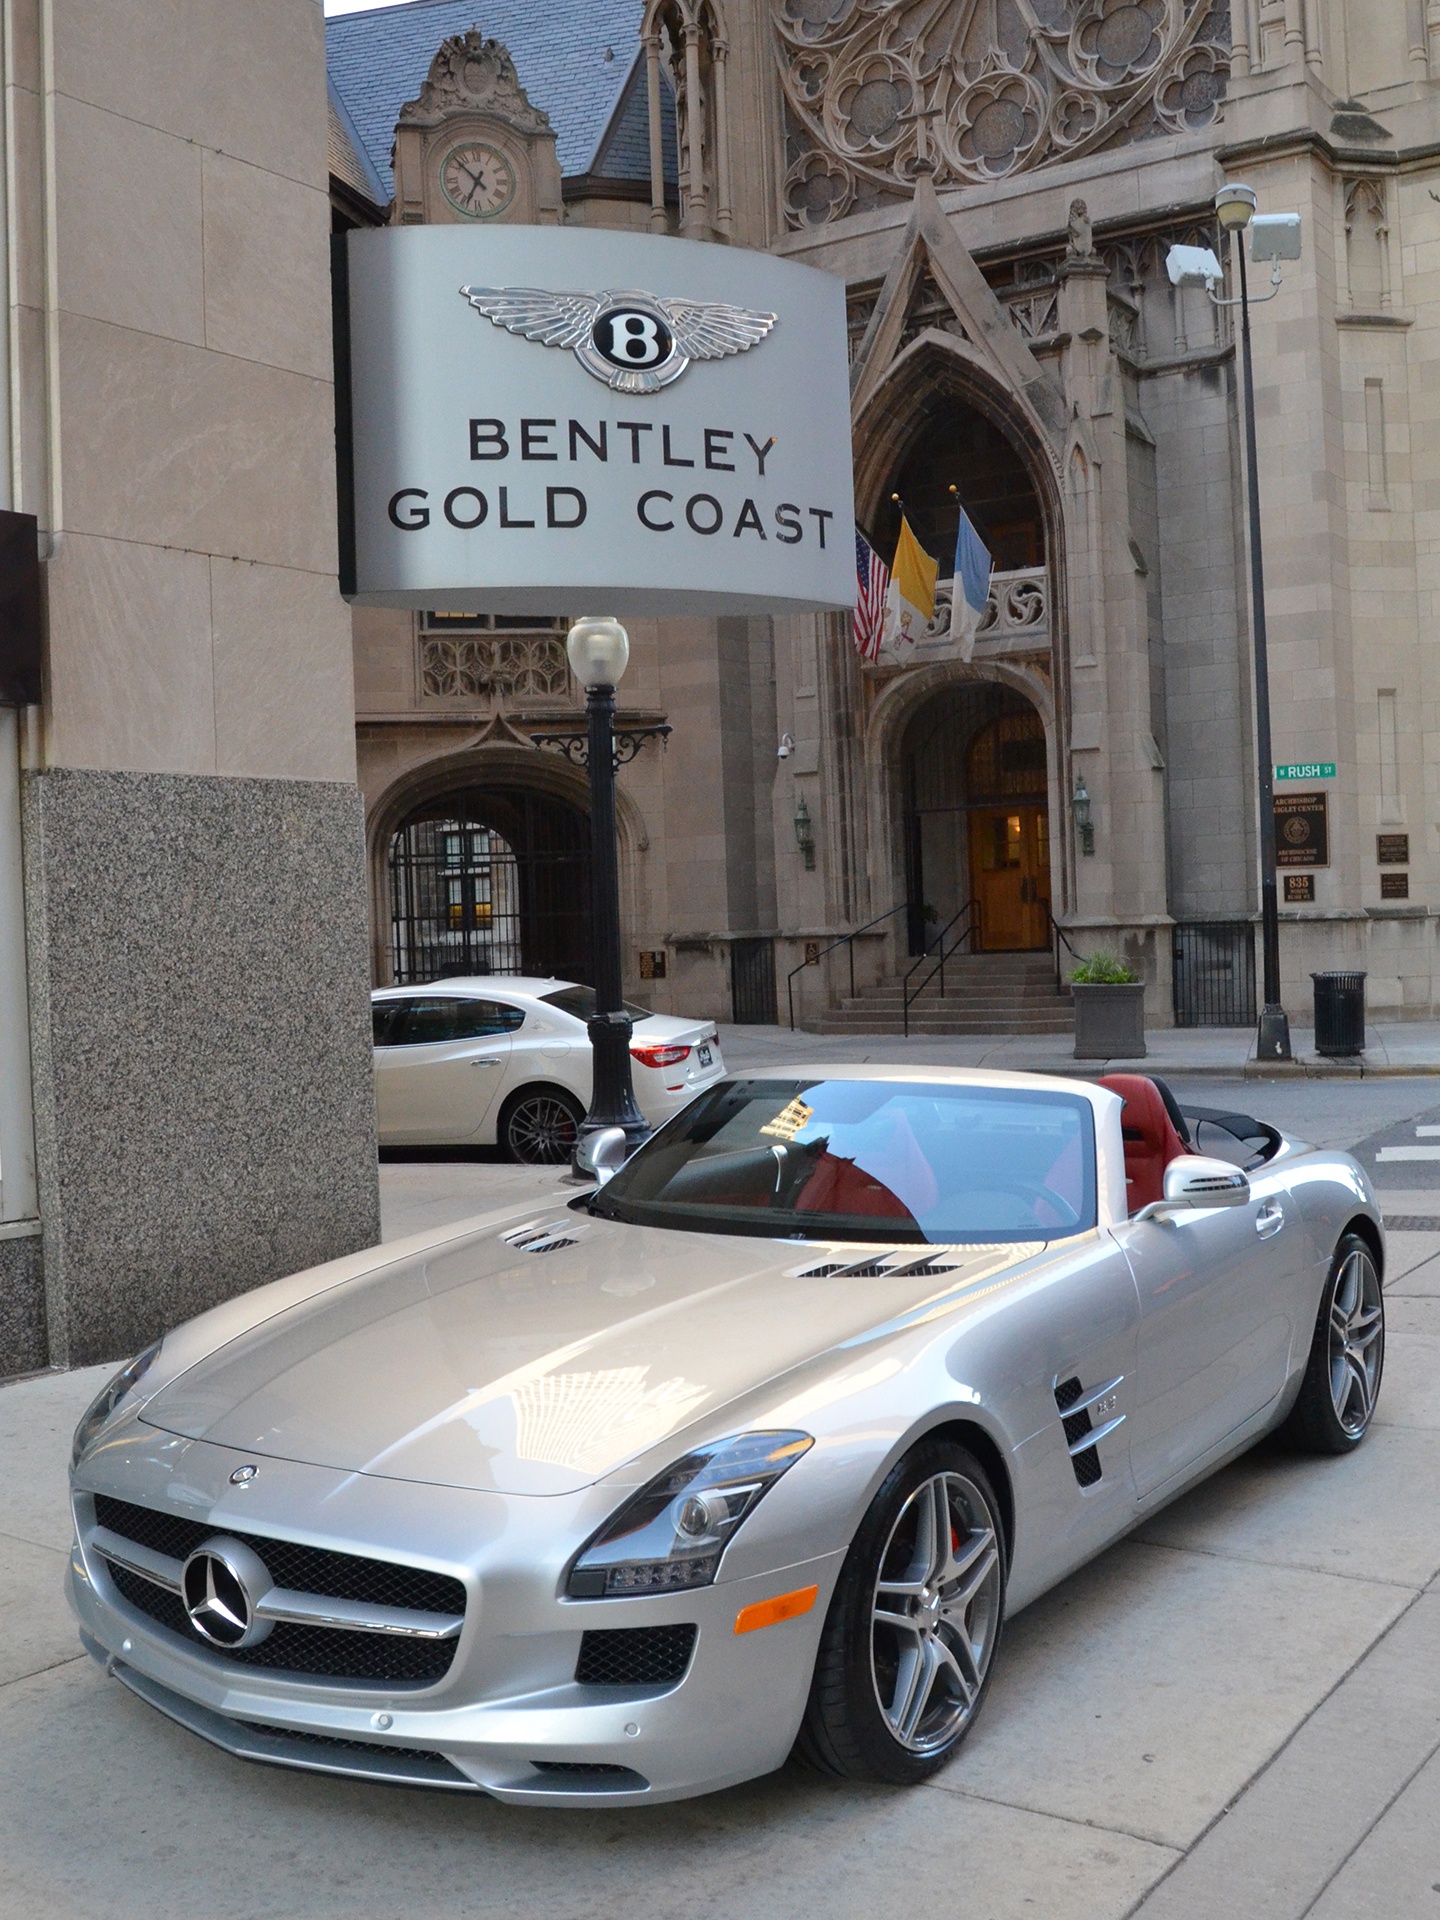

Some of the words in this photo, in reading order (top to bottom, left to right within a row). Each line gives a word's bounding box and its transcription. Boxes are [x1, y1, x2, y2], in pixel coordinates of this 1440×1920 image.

[608, 313, 659, 364] B
[469, 418, 778, 476] BENTLEY
[388, 486, 587, 531] GOLD
[637, 490, 834, 549] COAST
[1279, 768, 1285, 776] N
[1288, 765, 1320, 778] RUSH
[1324, 766, 1332, 774] ST
[1275, 797, 1317, 805] ARCHBISHOP
[1273, 805, 1296, 813] UIGLEY
[1297, 804, 1324, 812] CENTER
[1289, 877, 1309, 888] 835
